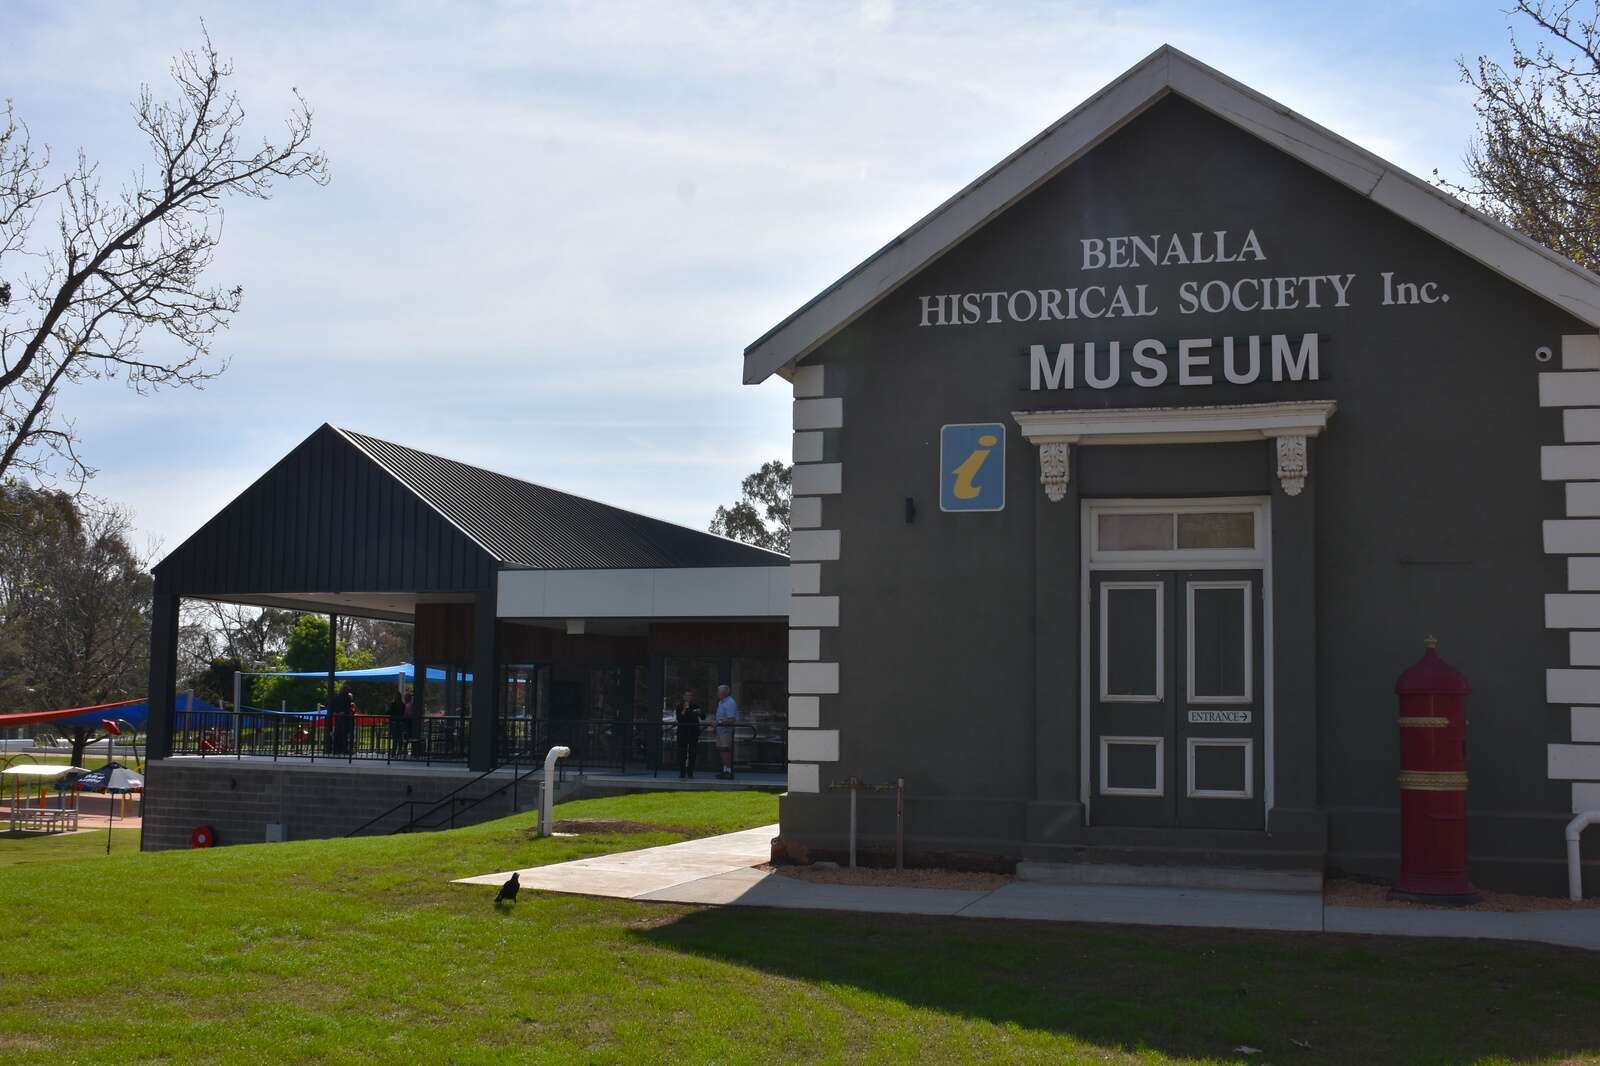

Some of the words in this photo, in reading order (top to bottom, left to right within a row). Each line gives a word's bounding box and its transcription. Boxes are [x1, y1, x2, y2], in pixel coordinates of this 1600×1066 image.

[1080, 228, 1267, 271] BENALLA
[919, 284, 1159, 327] HISTORICAL
[1178, 273, 1356, 315] SOCIETY
[1380, 271, 1451, 306] Inc.
[1029, 332, 1320, 391] MUSEUM
[1191, 711, 1239, 721] ENTRANCE
